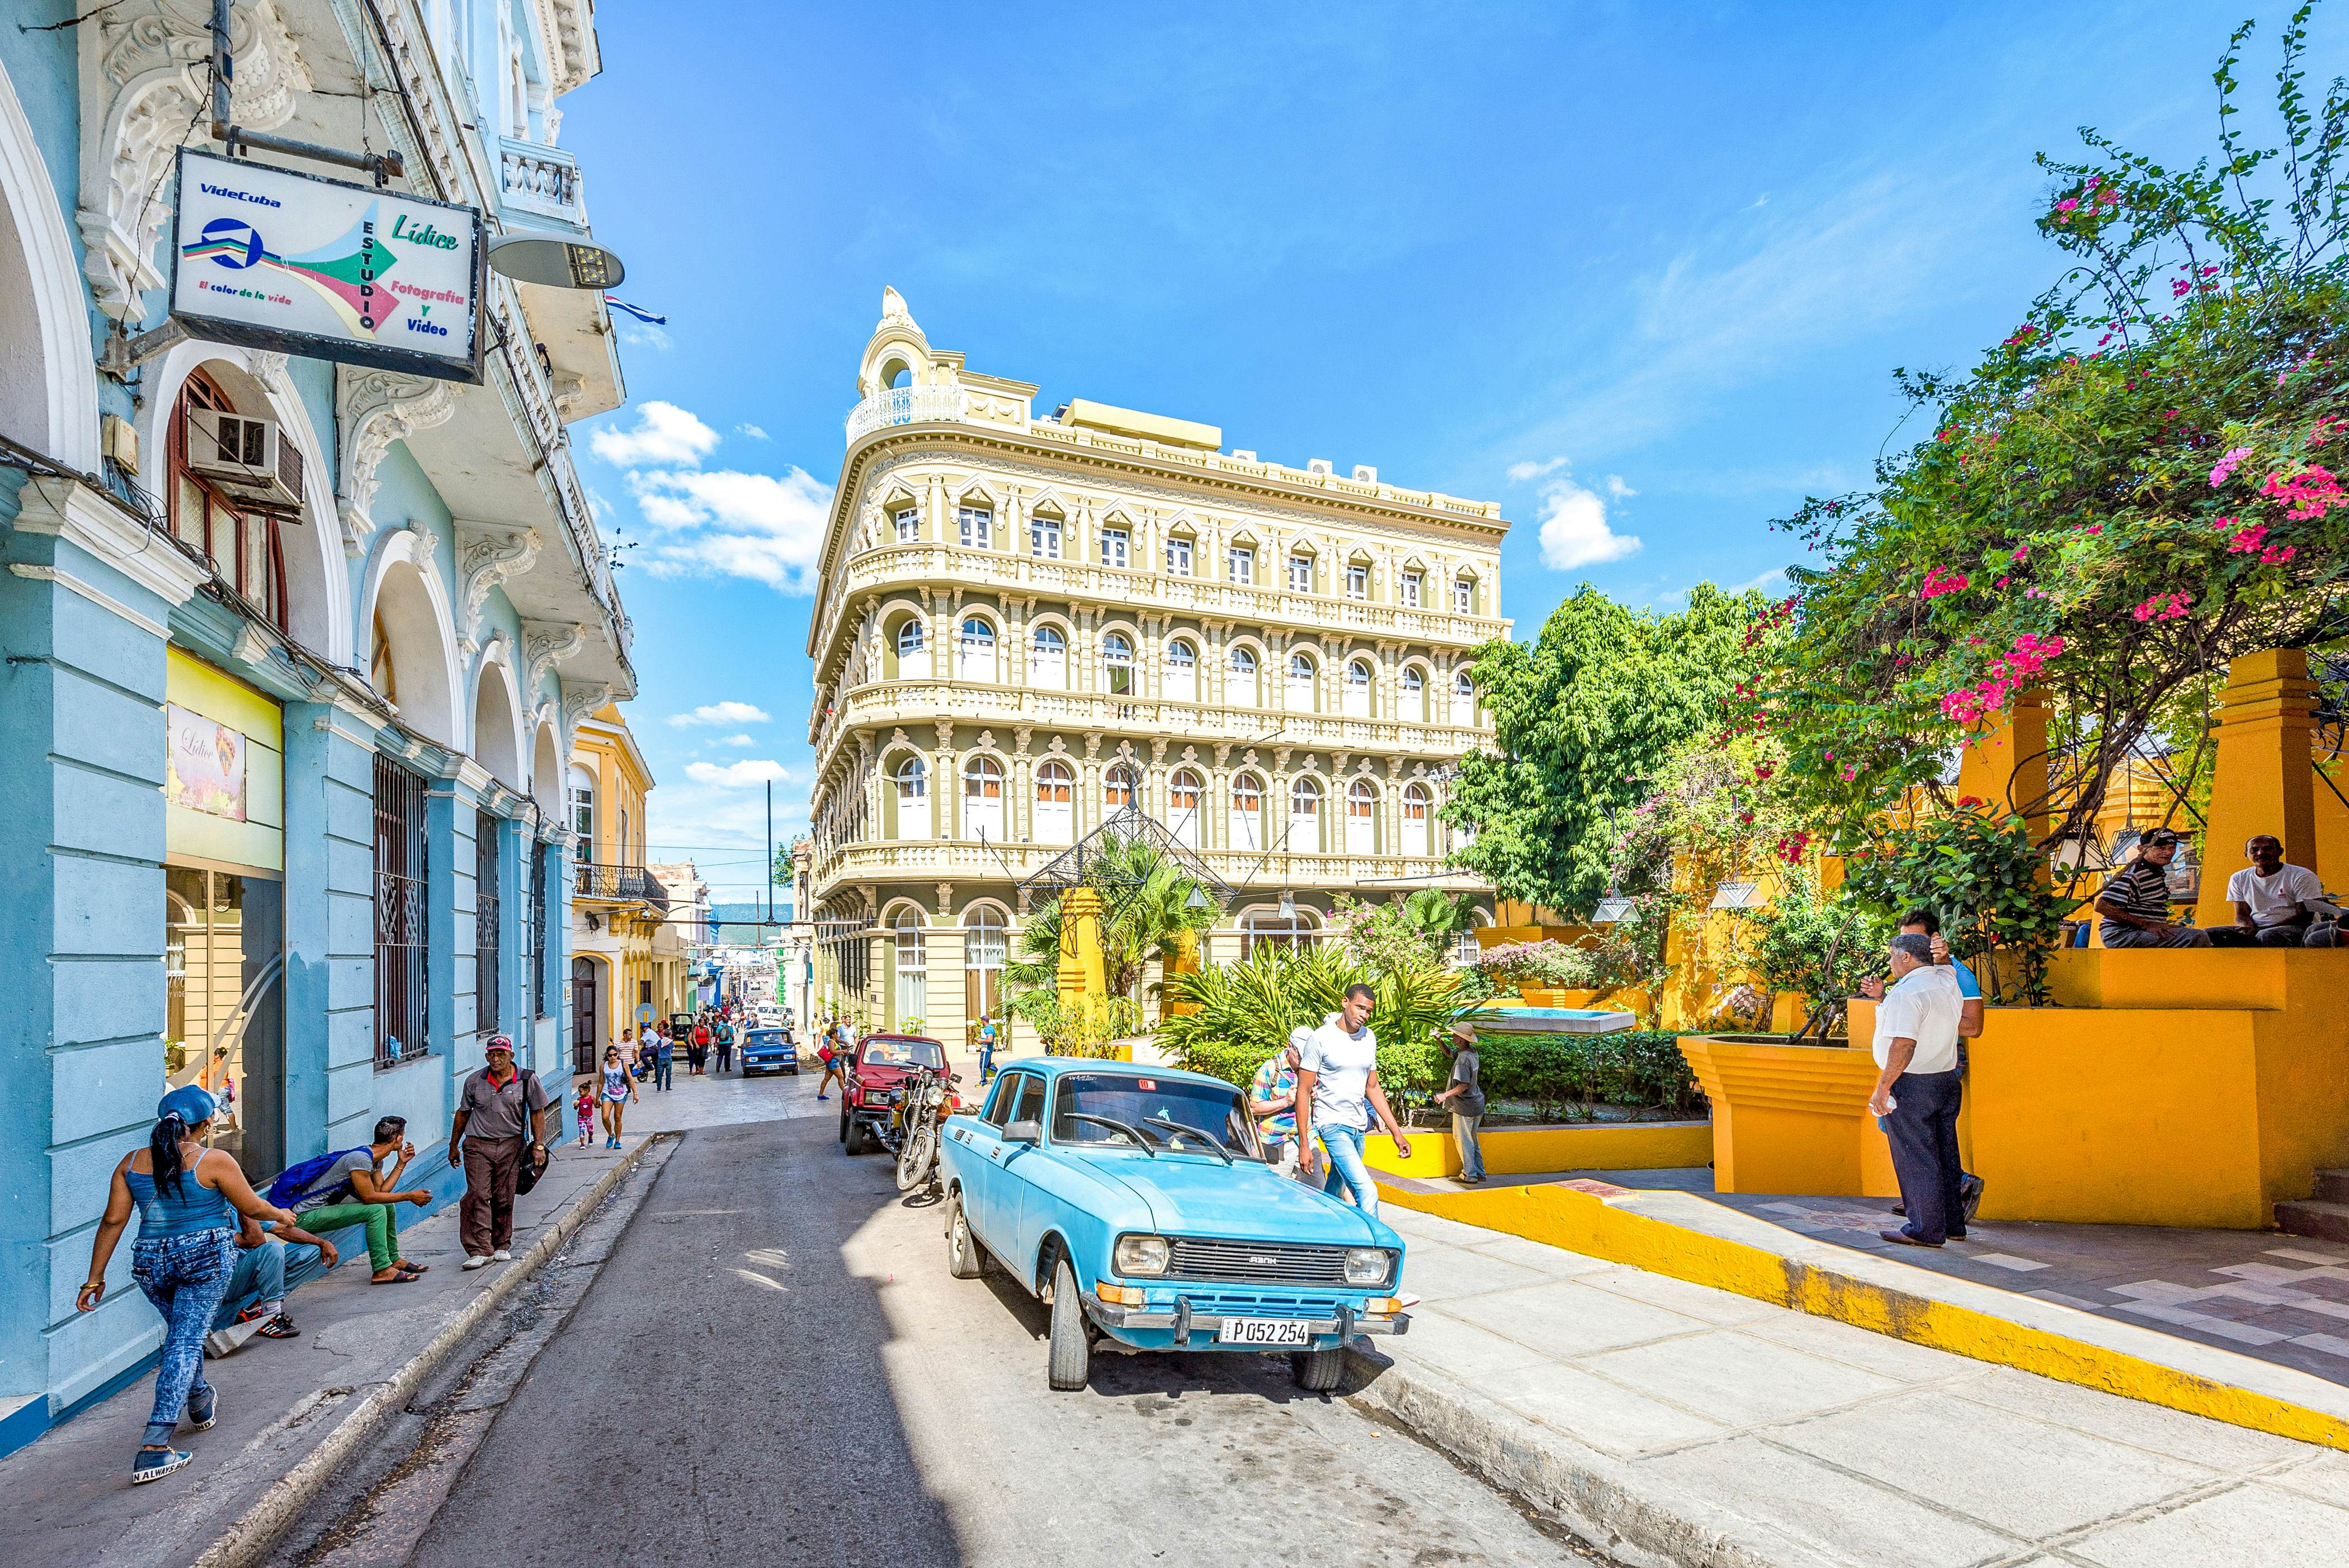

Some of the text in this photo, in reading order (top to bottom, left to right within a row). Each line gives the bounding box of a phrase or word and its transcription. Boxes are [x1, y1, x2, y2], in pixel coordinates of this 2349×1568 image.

[200, 183, 281, 208] VideCuba
[392, 215, 459, 251] Lídice
[360, 221, 375, 329] ESTUDIO
[199, 280, 292, 305] El color de la vida
[391, 280, 465, 305] Fotografía
[407, 318, 447, 336] Video
[180, 727, 214, 759] Lídice
[1233, 1322, 1306, 1343] P 052 254
[143, 1465, 175, 1480] ALWAYS
